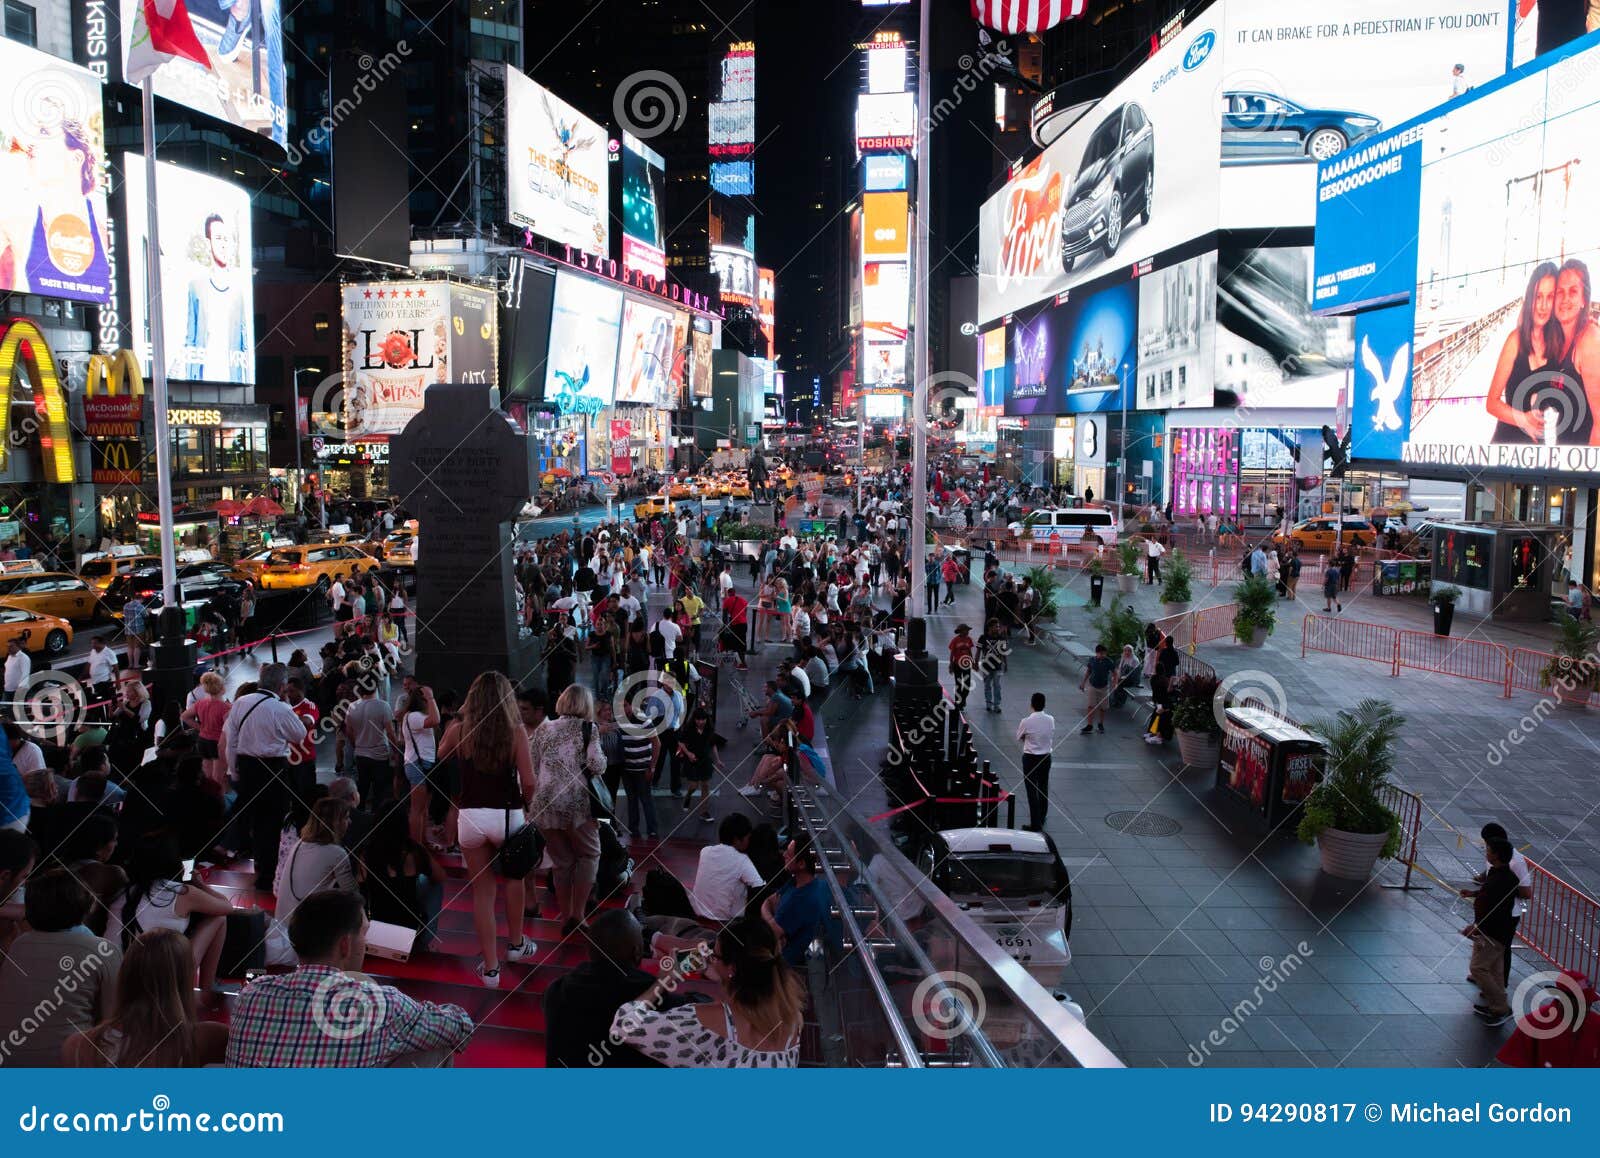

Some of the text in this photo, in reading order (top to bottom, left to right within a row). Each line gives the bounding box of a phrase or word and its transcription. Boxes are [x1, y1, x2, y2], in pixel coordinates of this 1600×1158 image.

[86, 0, 107, 57] KRIS
[1237, 11, 1501, 44] IT CAN BRAKE FOR A PEDESTRIAN IF YOU DON'T
[875, 31, 900, 43] 2016
[859, 137, 912, 149] TOSHIBA
[528, 147, 547, 168] THE
[608, 153, 619, 161] LG
[564, 243, 617, 278] 1540
[622, 264, 711, 312] BROADWAY
[363, 309, 374, 320] IN
[376, 309, 394, 320] 400
[86, 403, 141, 413] McDonald's
[1403, 443, 1491, 465] AMERICAN
[1497, 446, 1560, 470] EAGLE
